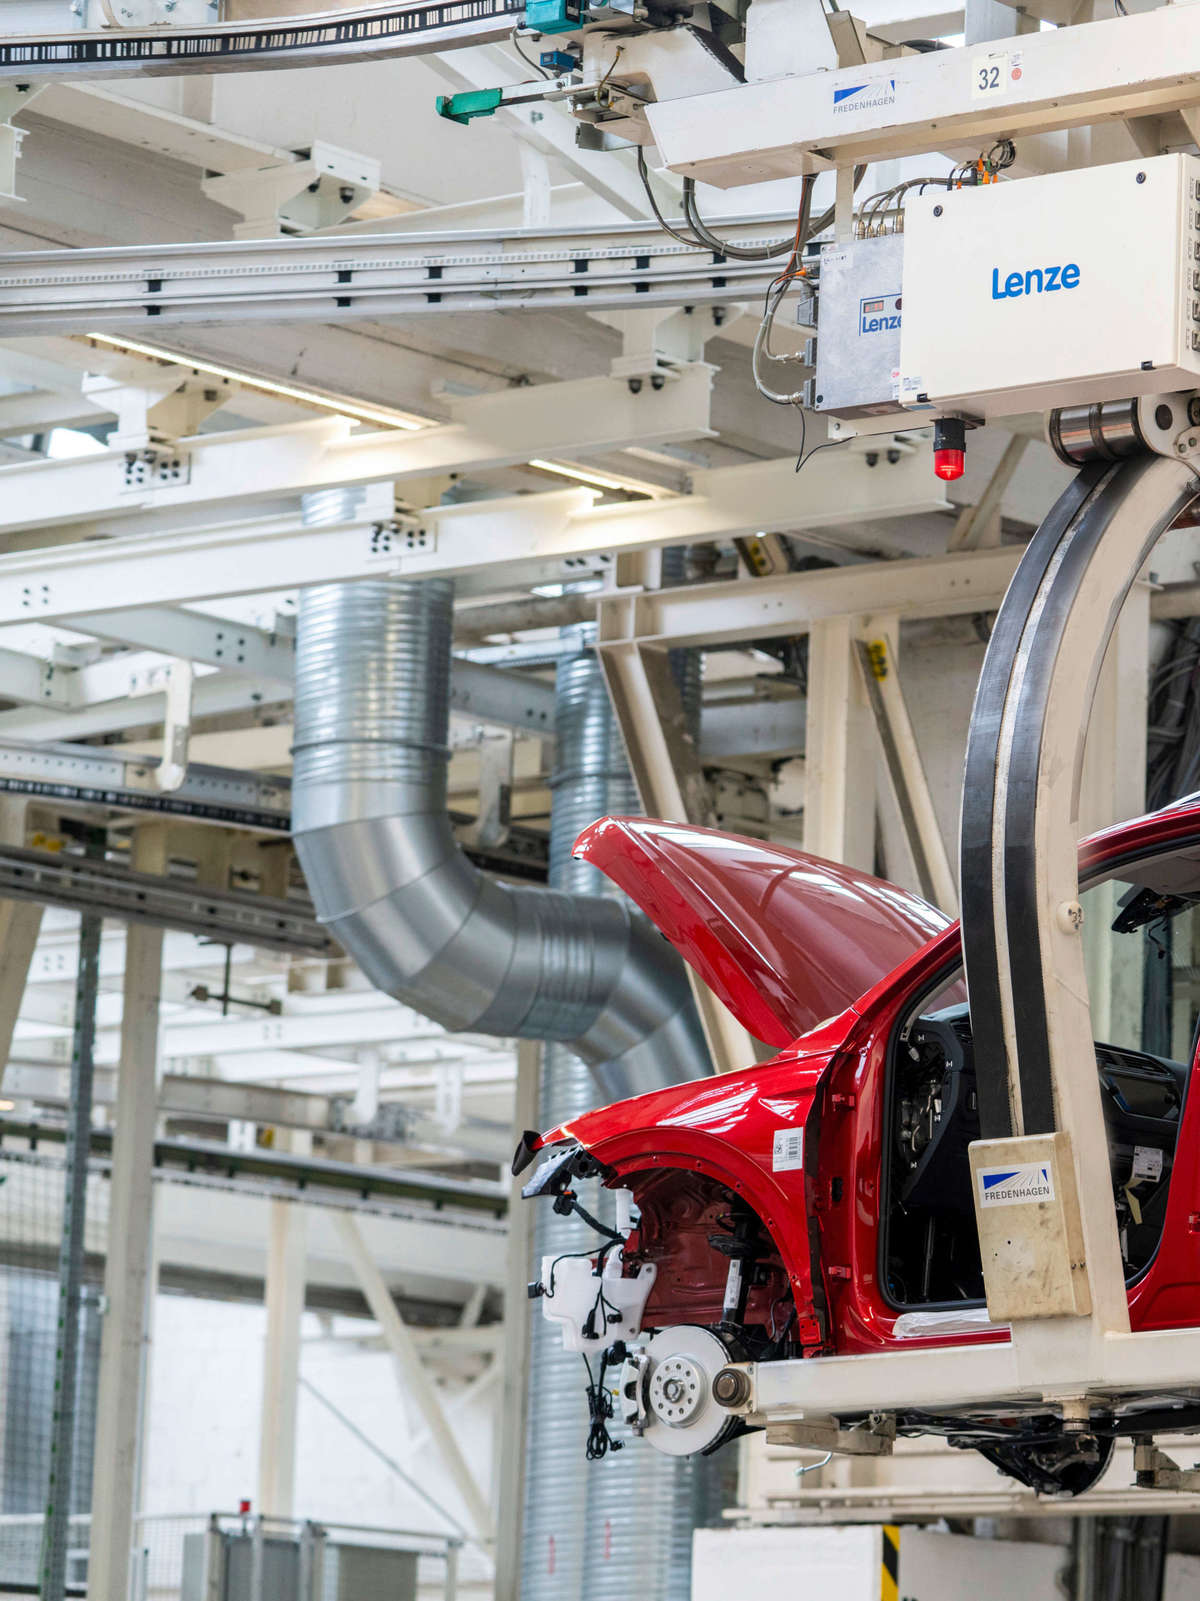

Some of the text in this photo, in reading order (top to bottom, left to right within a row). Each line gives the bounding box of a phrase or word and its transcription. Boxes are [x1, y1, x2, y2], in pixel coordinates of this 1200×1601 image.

[979, 66, 1000, 90] 32
[833, 96, 895, 113] FREDENHAGEN
[992, 263, 1081, 300] Lenze
[985, 1186, 1050, 1200] FREDENHAGEN
